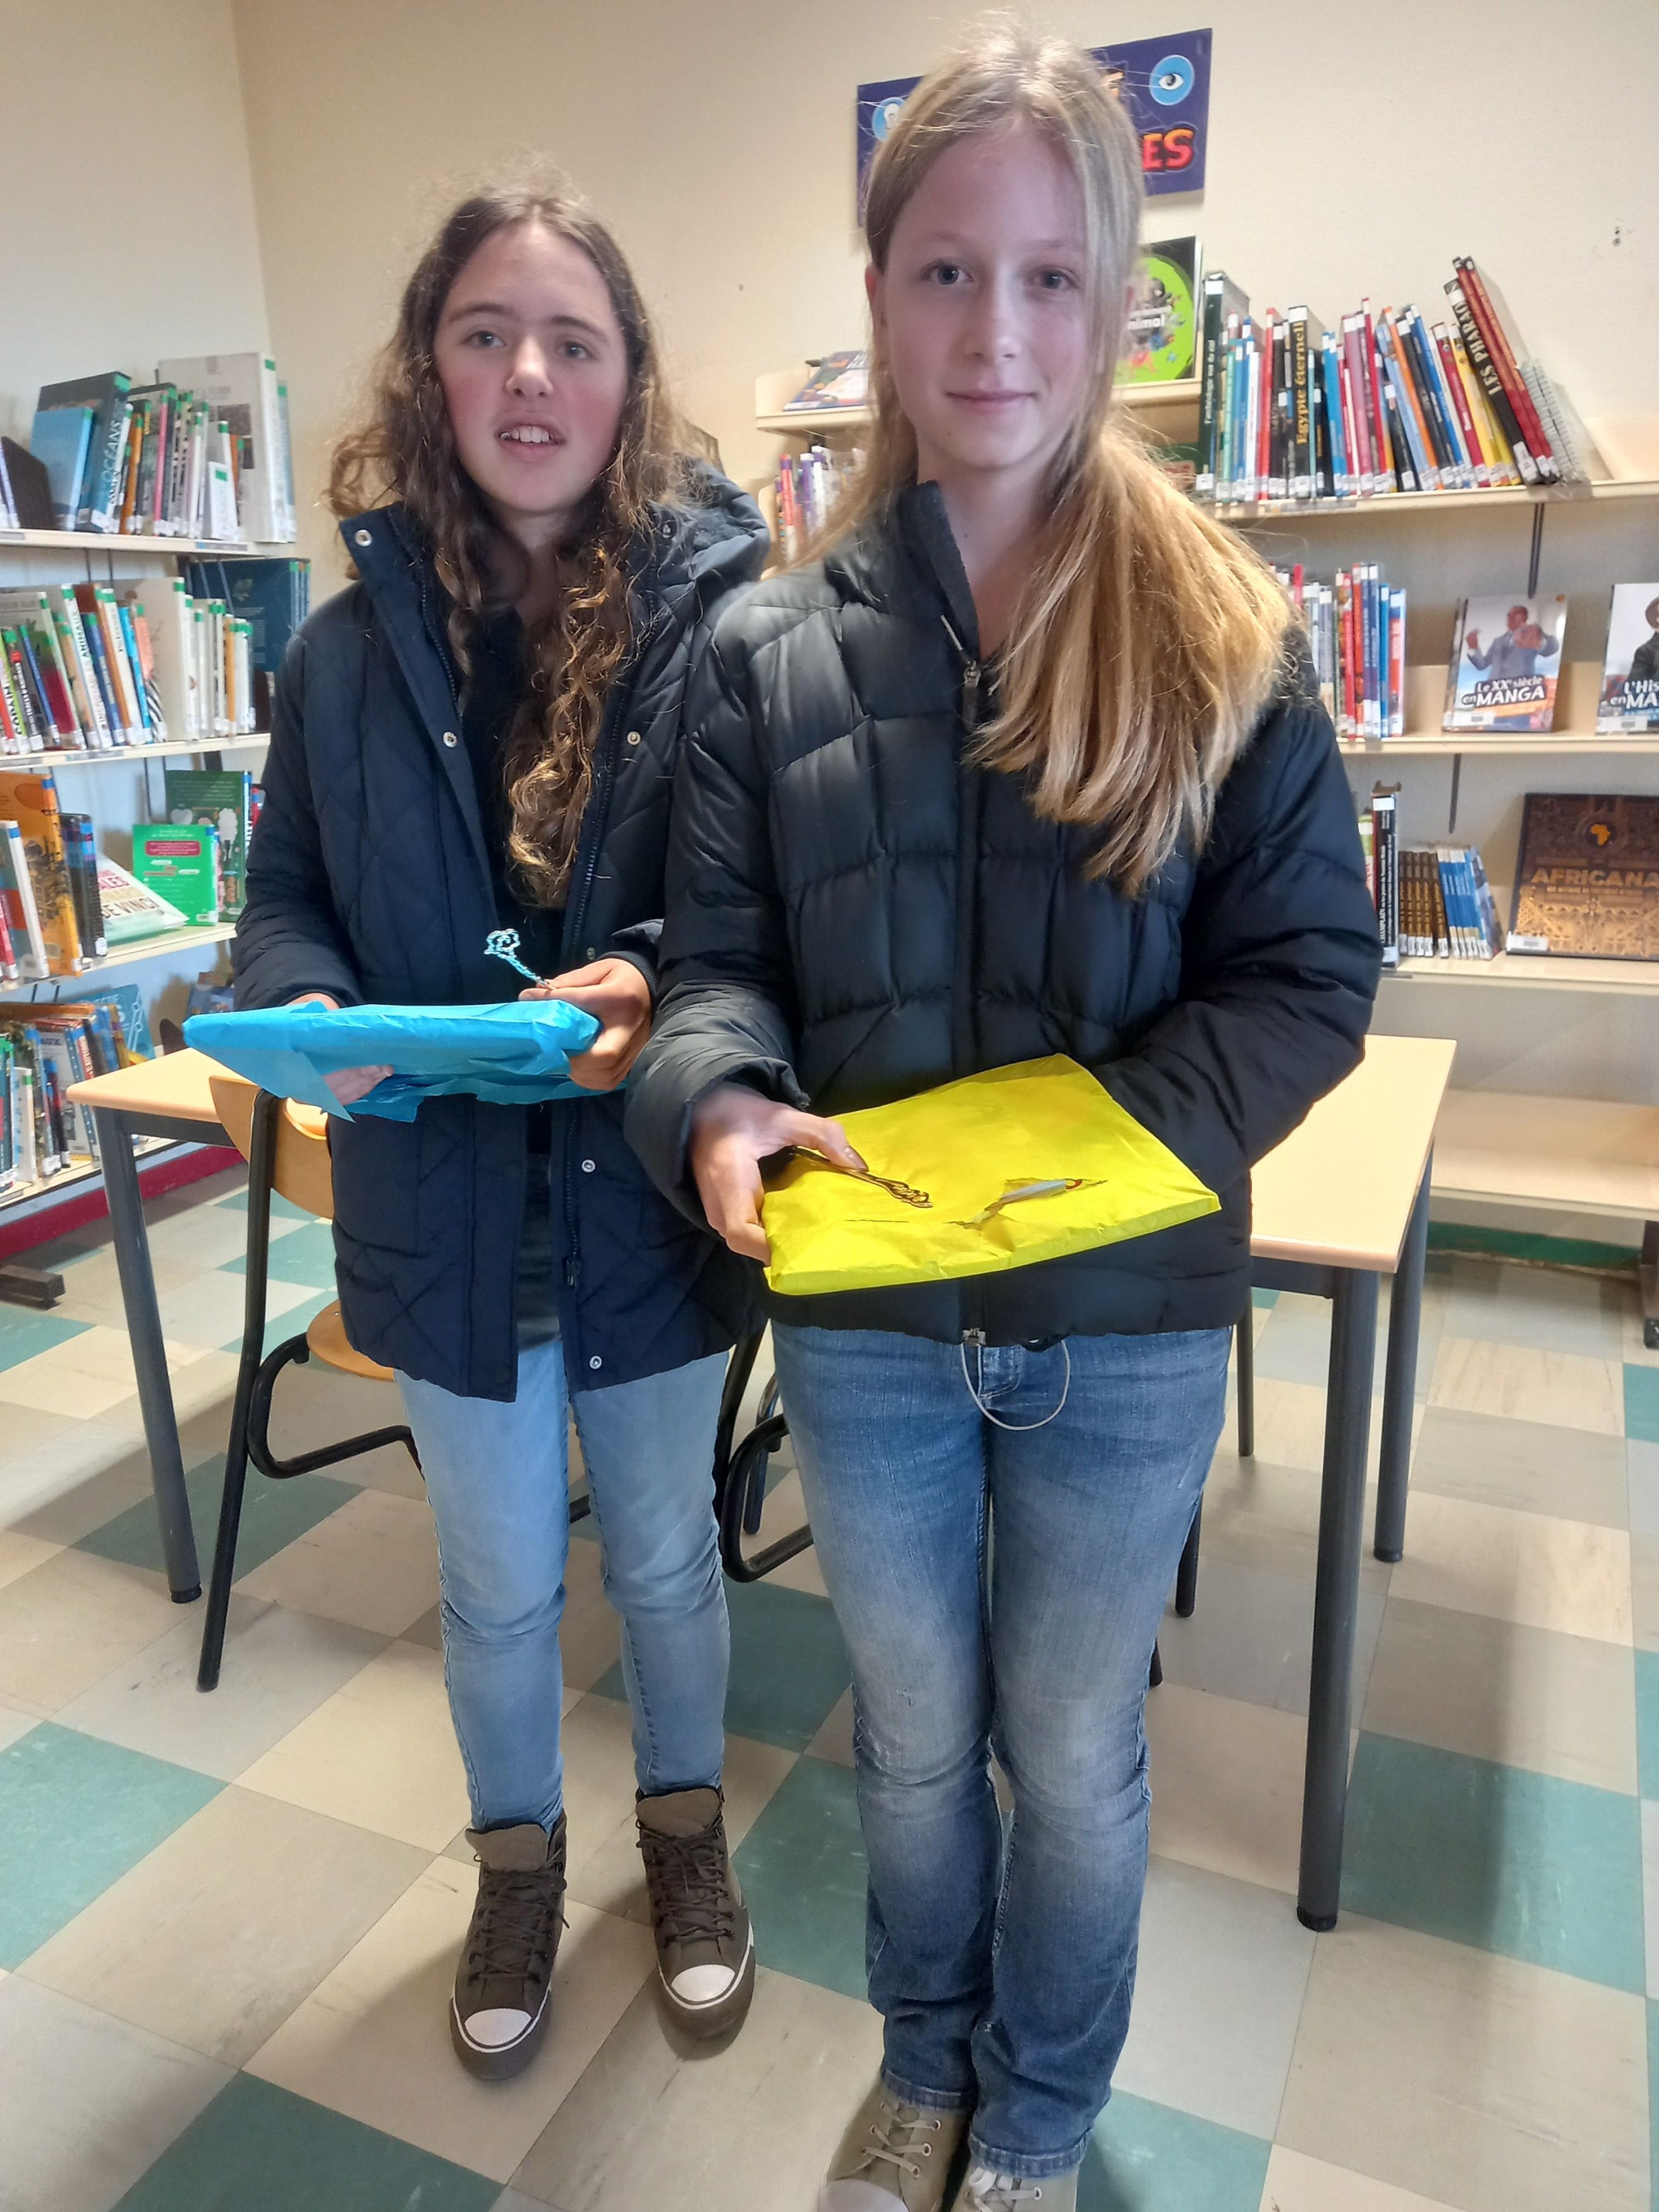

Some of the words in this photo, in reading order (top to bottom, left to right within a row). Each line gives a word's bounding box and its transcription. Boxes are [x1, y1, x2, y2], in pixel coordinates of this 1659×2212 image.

[1143, 128, 1194, 171] ES
[1127, 315, 1165, 330] nimal
[1454, 300, 1488, 363] PHARAO
[1294, 321, 1307, 386] éternell
[1481, 364, 1502, 396] LES
[1476, 685, 1545, 707] MANGA
[1478, 681, 1490, 692] Le
[1624, 679, 1659, 694] L'HIS
[1626, 691, 1659, 709] MA
